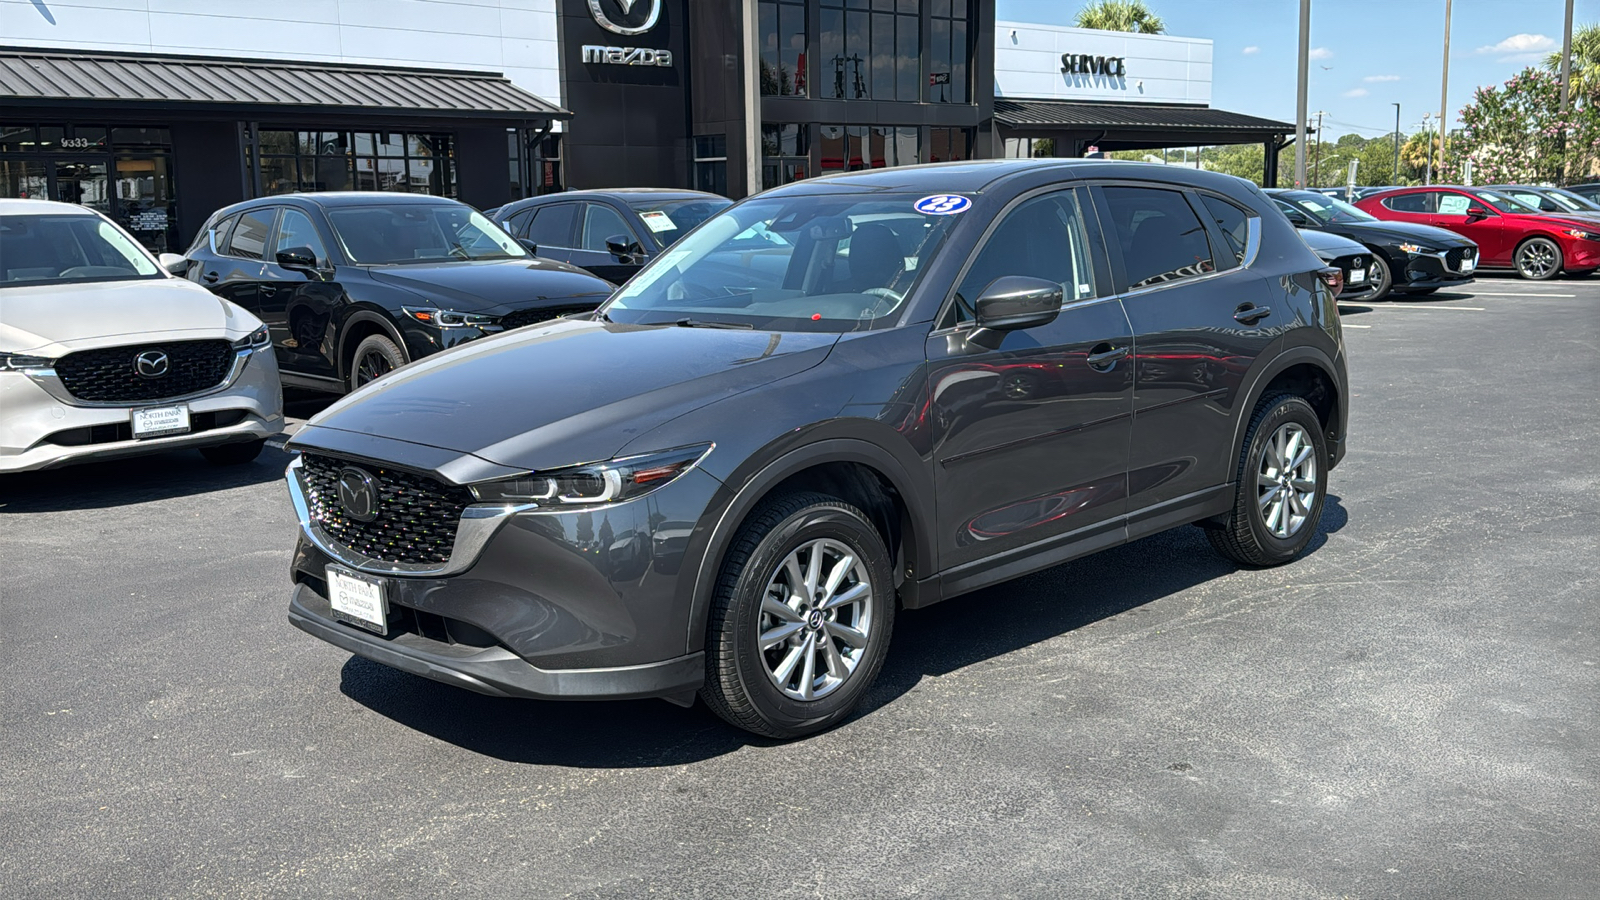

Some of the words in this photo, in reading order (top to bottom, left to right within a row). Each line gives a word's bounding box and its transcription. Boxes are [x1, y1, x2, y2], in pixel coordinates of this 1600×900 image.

[1060, 53, 1126, 76] SERVICE
[61, 138, 87, 147] 9333
[921, 196, 961, 211] 23
[140, 412, 163, 420] NORTH
[164, 409, 181, 417] PARK
[335, 578, 357, 593] NORTH
[358, 584, 374, 599] PARK
